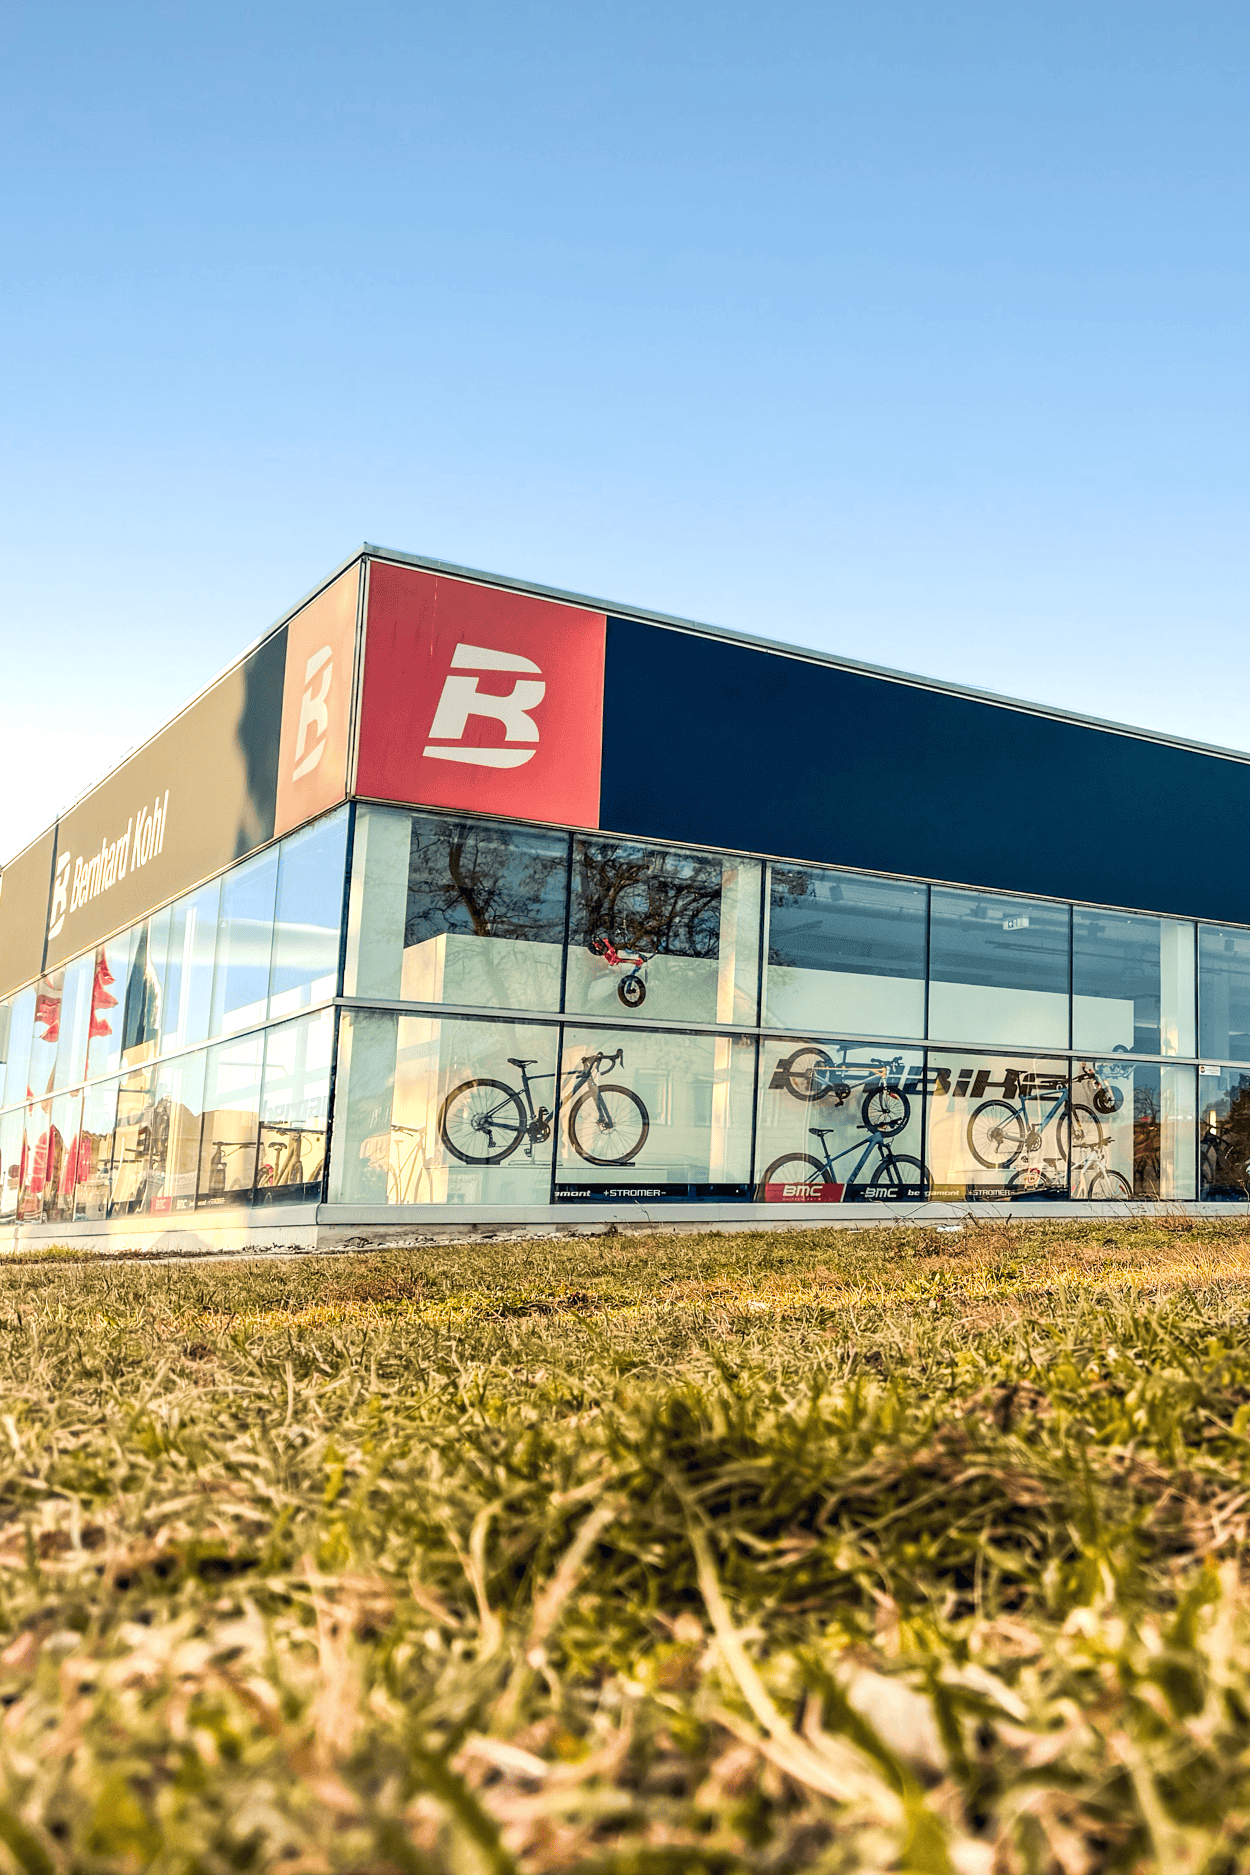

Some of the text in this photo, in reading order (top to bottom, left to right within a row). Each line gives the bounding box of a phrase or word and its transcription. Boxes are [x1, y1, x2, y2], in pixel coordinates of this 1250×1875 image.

[70, 789, 169, 914] Bernhard Kohl
[783, 1185, 823, 1197] BMC
[864, 1187, 899, 1198] BMC
